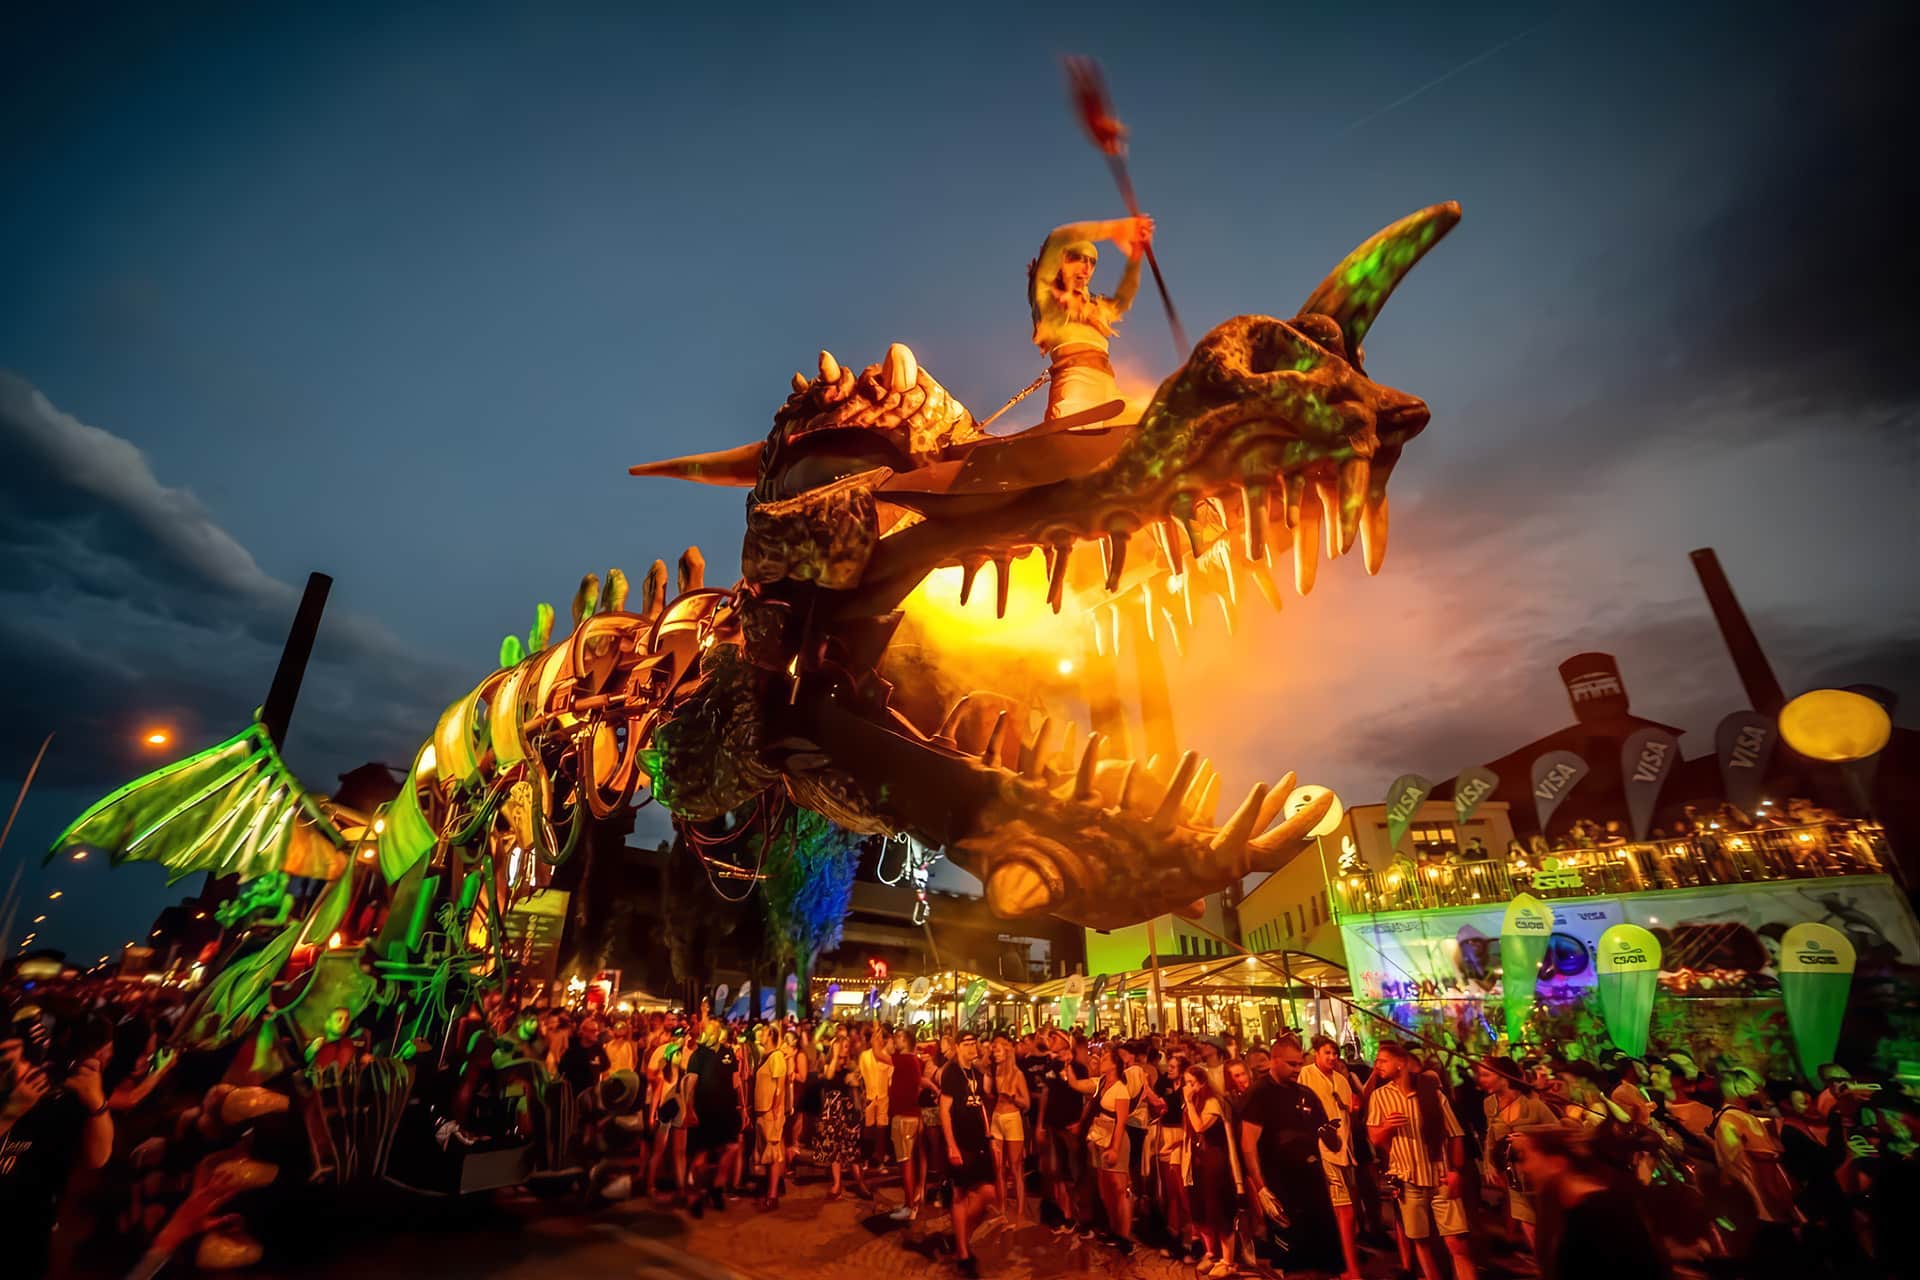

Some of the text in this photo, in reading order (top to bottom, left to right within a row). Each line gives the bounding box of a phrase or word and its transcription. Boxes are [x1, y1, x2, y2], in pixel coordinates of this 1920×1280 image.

[1632, 742, 1668, 782] VISA
[1729, 726, 1766, 768] VISA
[1455, 778, 1491, 813] VISA
[1535, 763, 1577, 800] VISA
[1388, 786, 1424, 823] VISA
